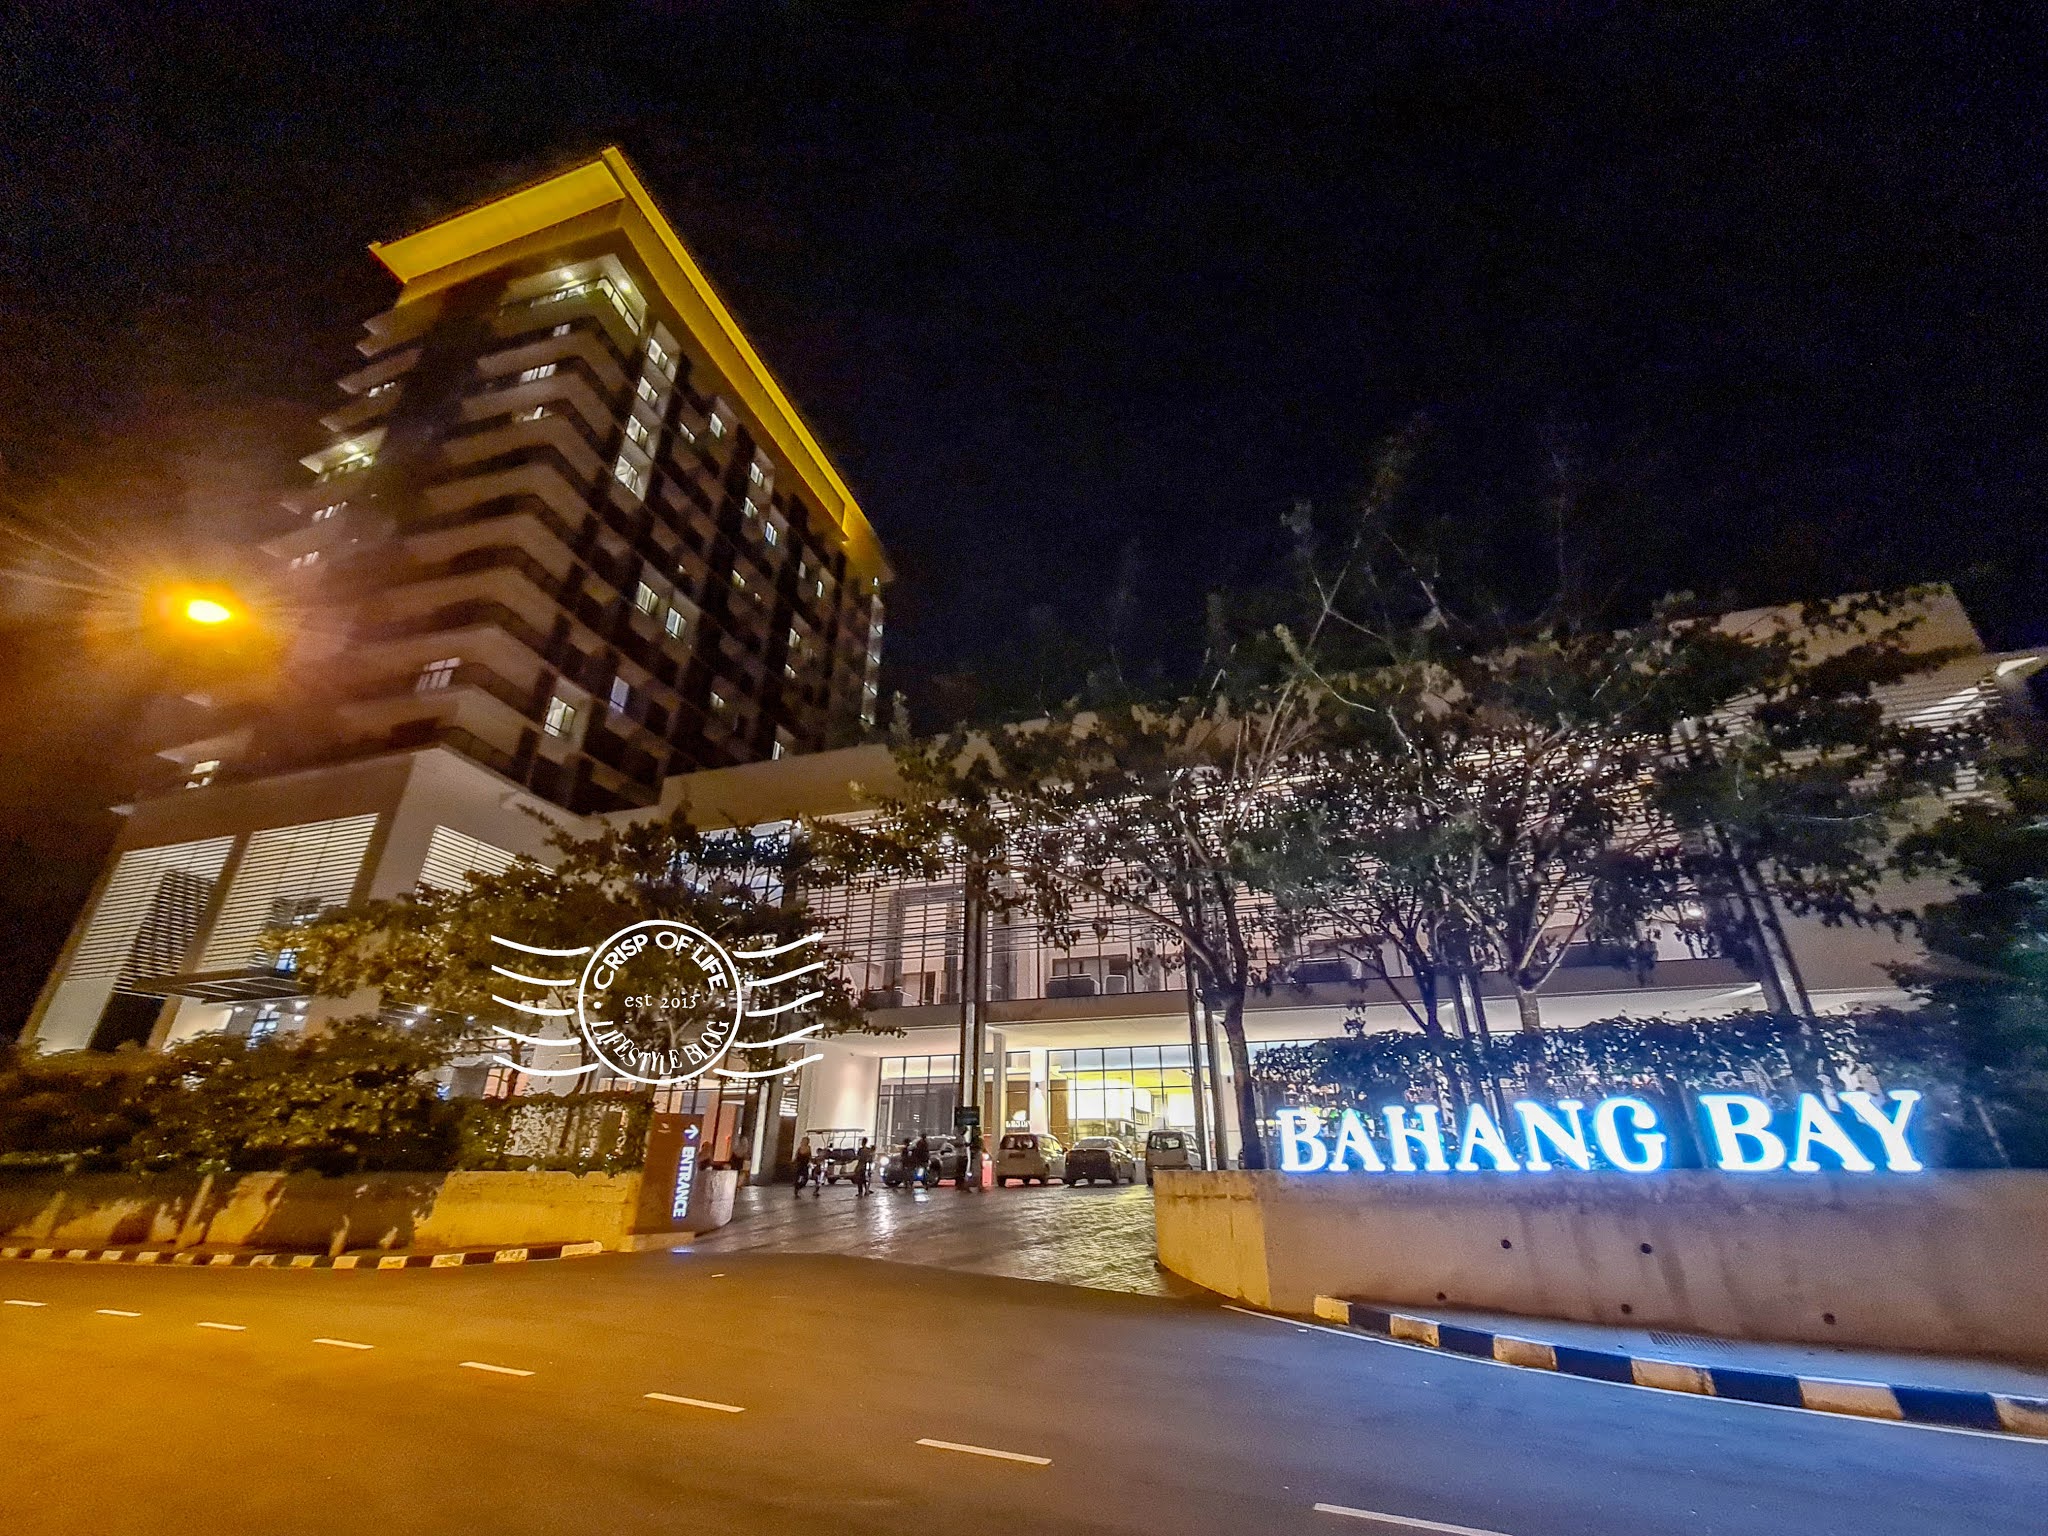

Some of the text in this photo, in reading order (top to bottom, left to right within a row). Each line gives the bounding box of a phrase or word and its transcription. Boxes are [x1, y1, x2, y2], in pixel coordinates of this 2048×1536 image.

[1276, 1089, 1923, 1173] BAHANG BAY
[672, 1145, 697, 1219] ENTRANCE
